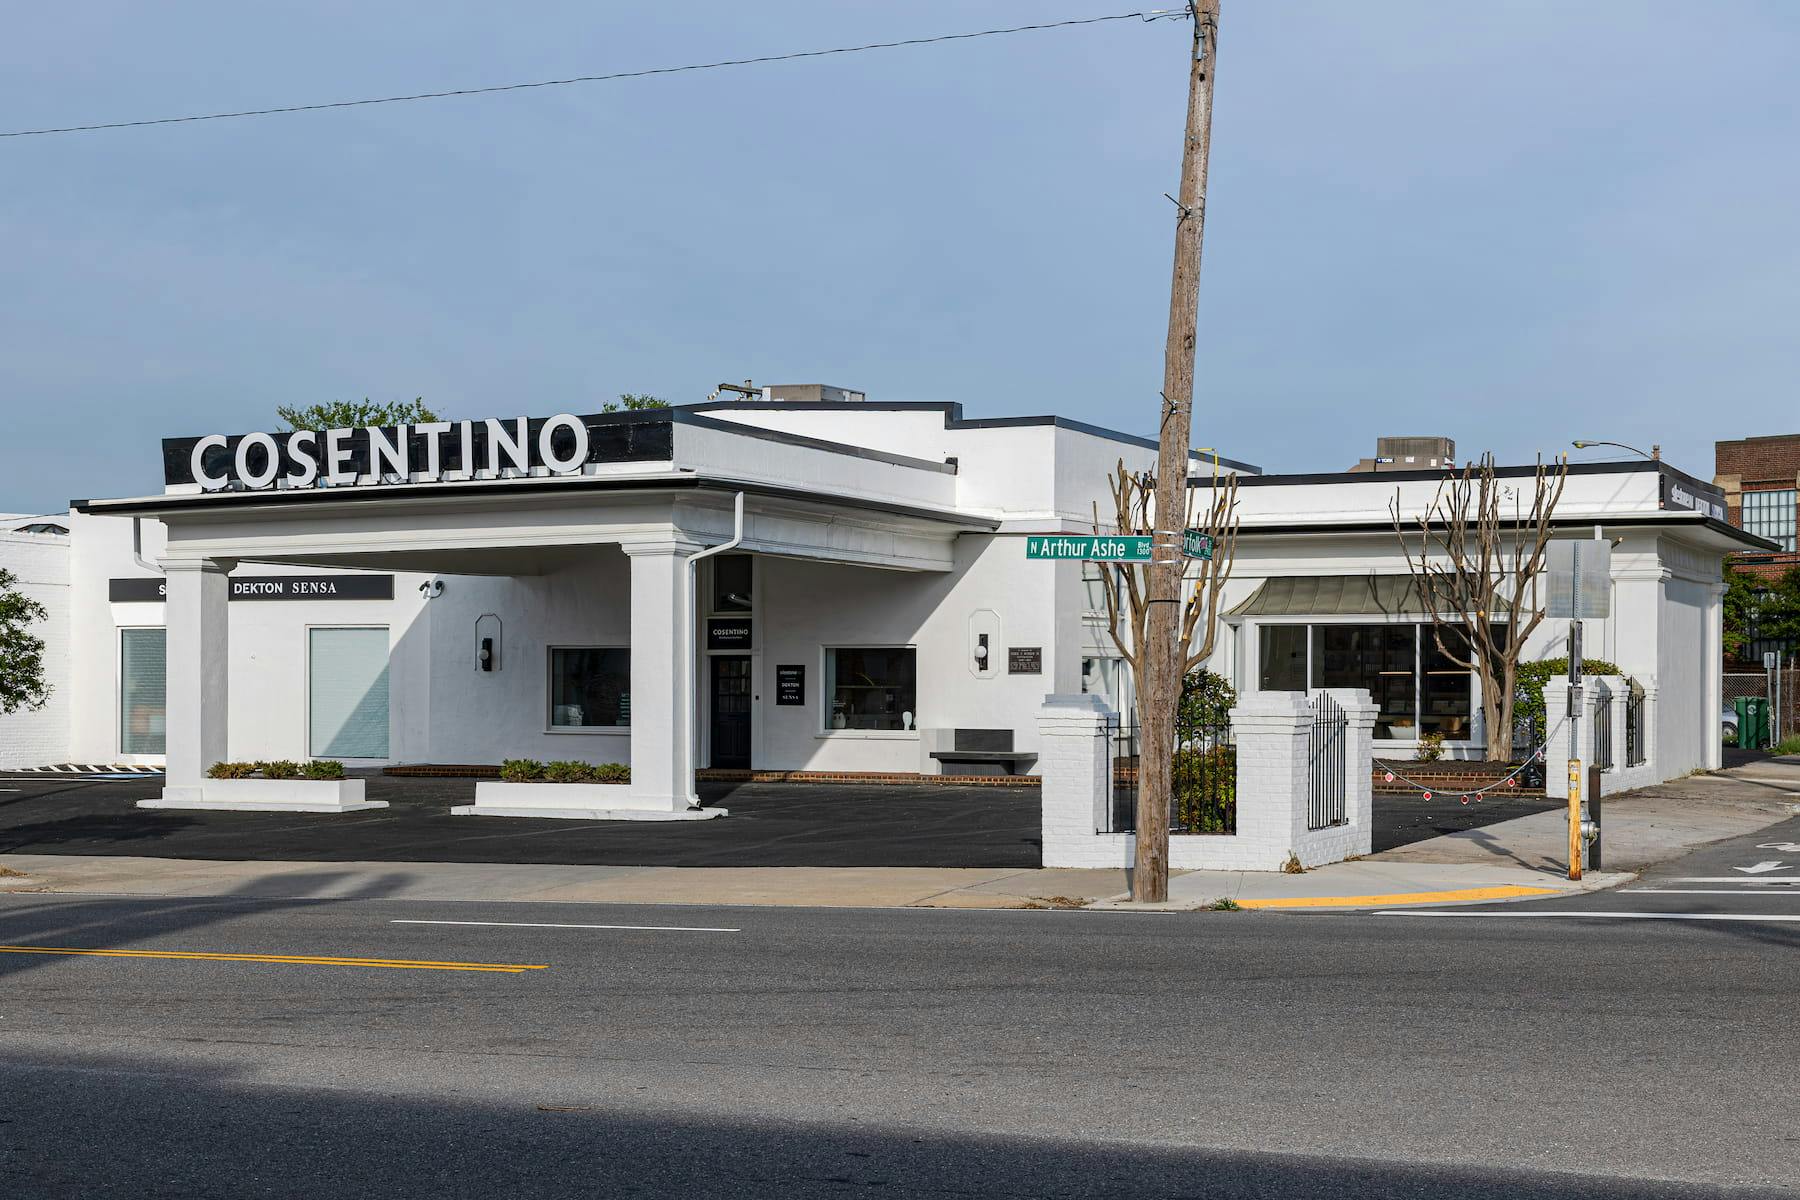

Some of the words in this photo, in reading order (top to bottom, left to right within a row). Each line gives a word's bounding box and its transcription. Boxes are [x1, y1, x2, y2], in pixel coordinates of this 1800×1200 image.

[190, 413, 590, 490] COSENTINO
[1030, 541, 1037, 554] N
[1040, 539, 1087, 557] Arthur
[1091, 539, 1126, 557] Ashe
[1137, 541, 1150, 549] Blvd
[234, 582, 283, 594] DEKTON
[292, 581, 337, 594] SENSA
[712, 628, 749, 636] COSENTINO
